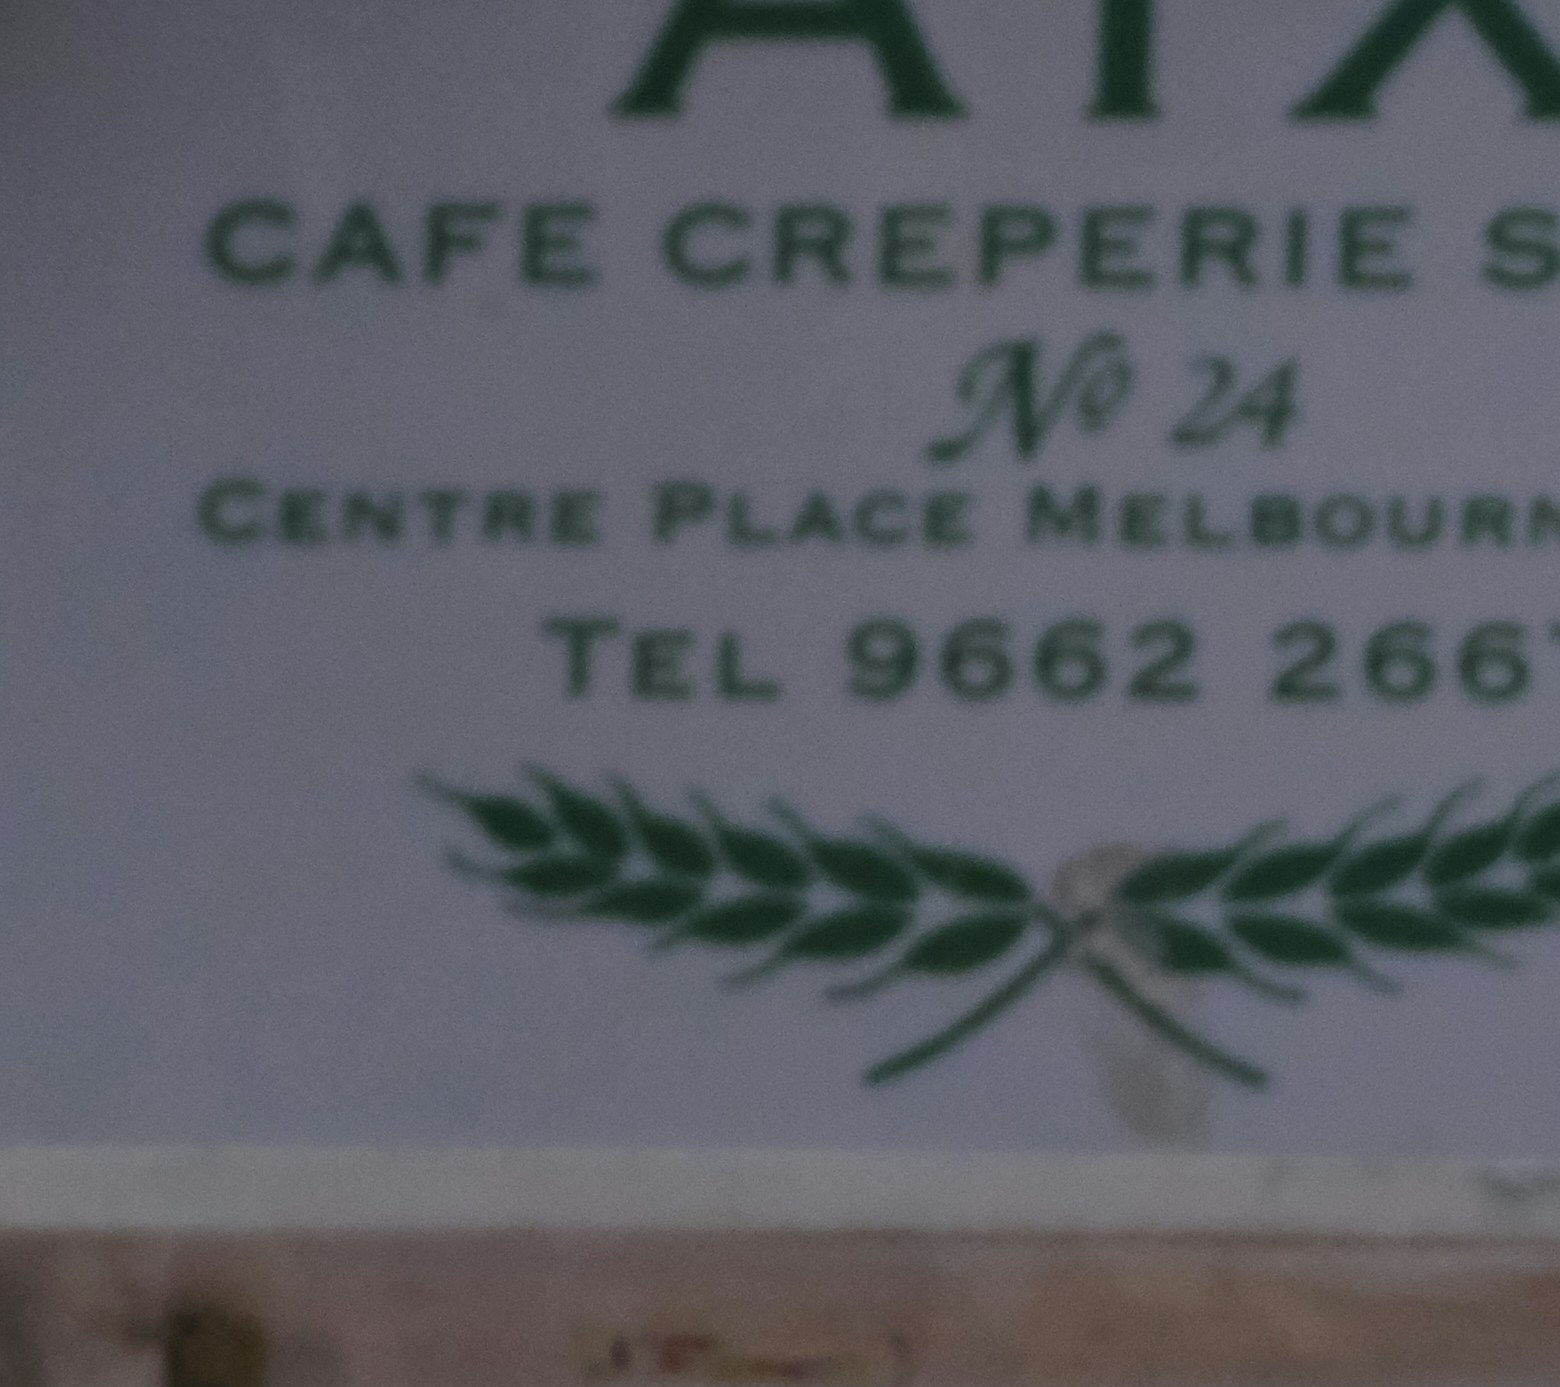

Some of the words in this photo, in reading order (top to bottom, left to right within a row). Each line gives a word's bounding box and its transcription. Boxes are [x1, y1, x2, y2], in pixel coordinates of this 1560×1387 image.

[208, 201, 594, 288] CAFE
[661, 201, 1411, 290] CREPERIE
[1170, 356, 1299, 453] 24
[200, 479, 594, 546] CENTRE
[652, 481, 969, 548] PLACE
[844, 618, 1199, 705] 9662
